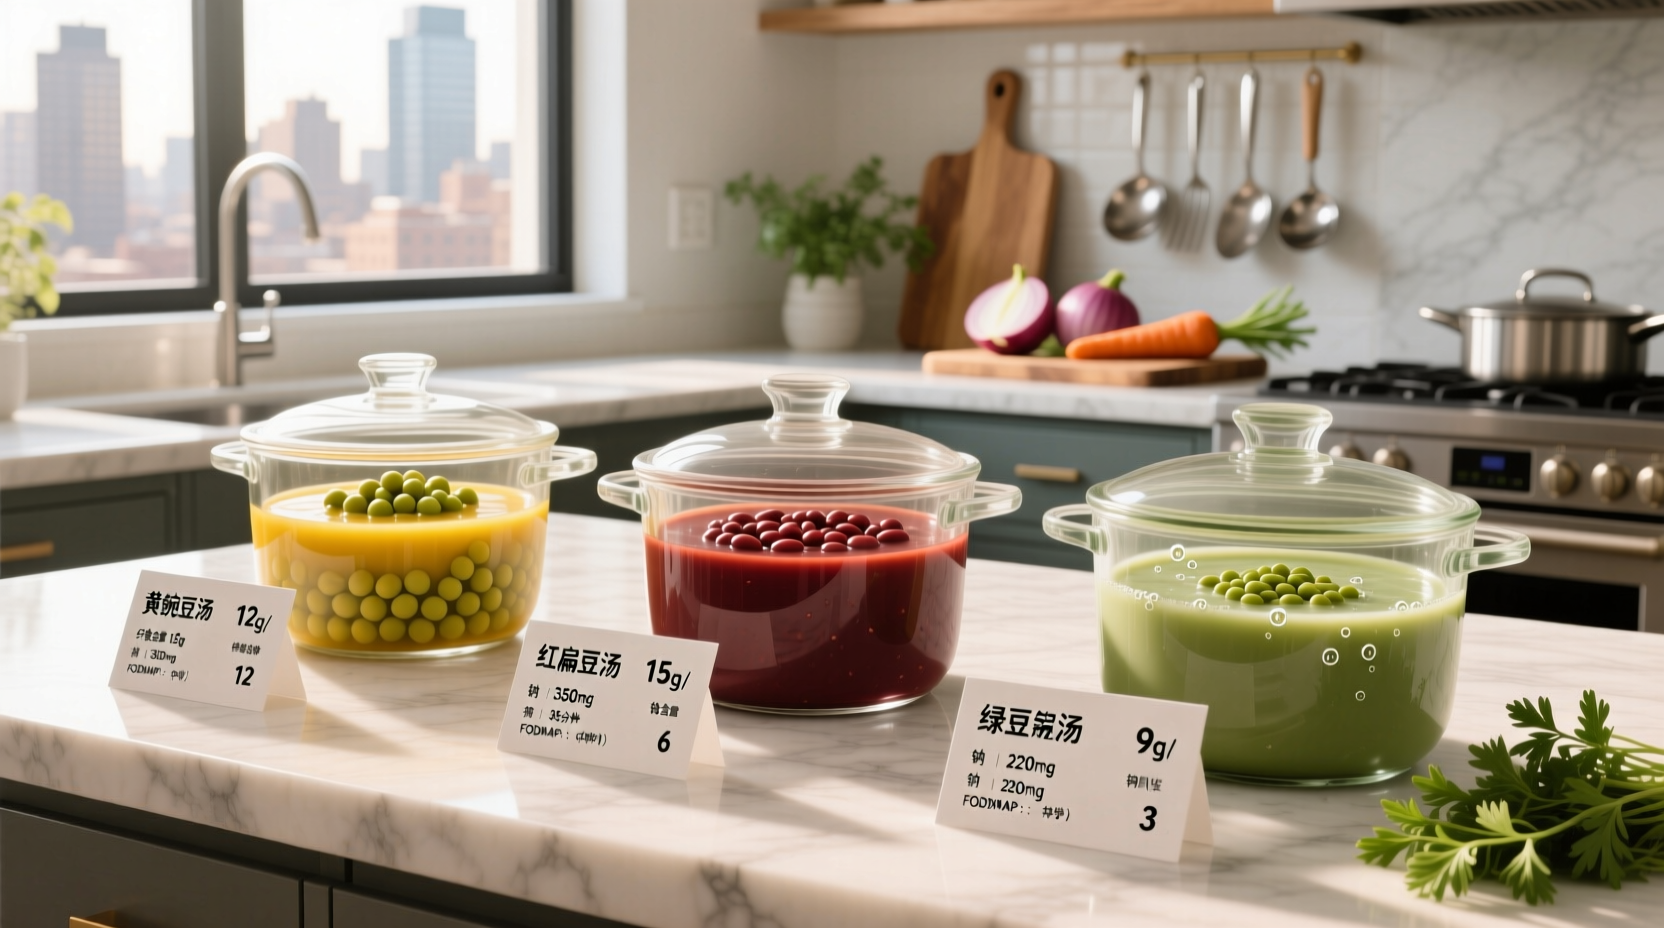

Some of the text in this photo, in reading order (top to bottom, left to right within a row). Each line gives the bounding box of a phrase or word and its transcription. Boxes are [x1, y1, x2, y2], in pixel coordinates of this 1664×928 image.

[536, 643, 622, 678] 红扁豆汤
[235, 665, 255, 686] 12
[646, 659, 691, 691] 15g/
[657, 730, 671, 753] 6
[1136, 727, 1177, 762] 9g/
[1006, 753, 1056, 778] 220mg
[1000, 778, 1045, 802] 220mg
[1138, 805, 1158, 831] 3
